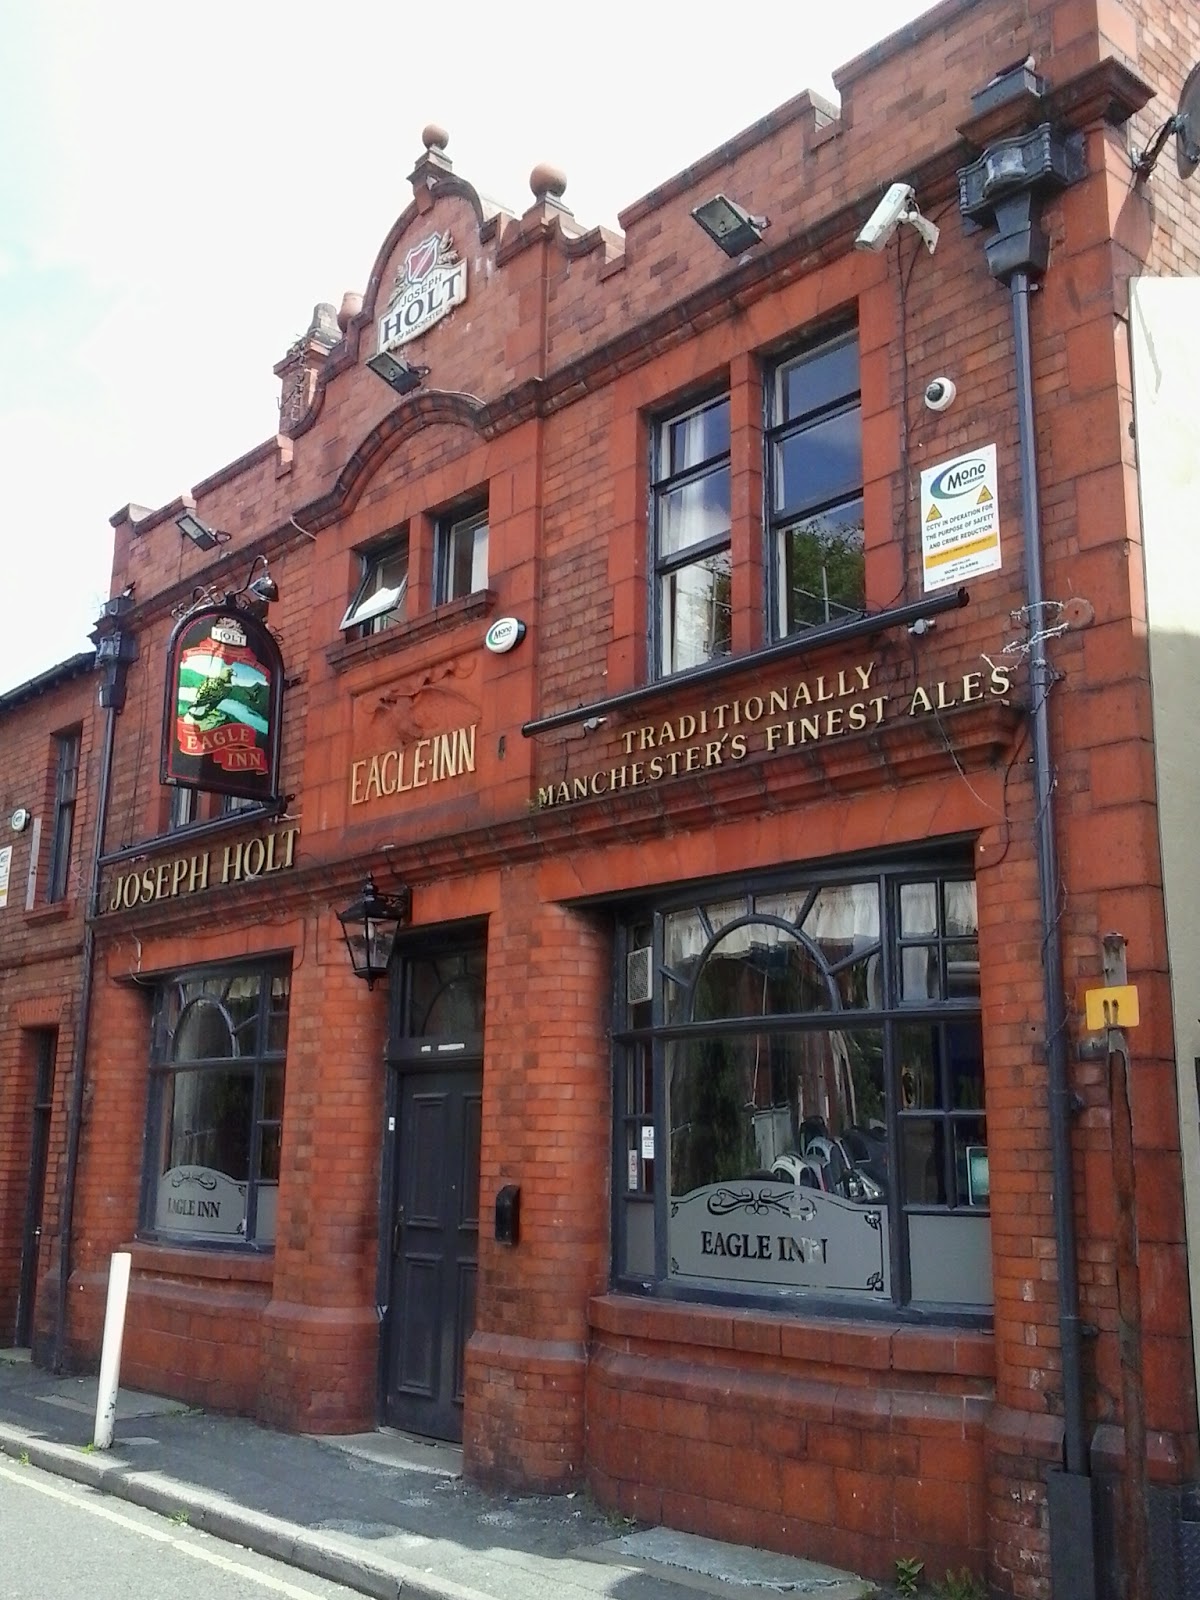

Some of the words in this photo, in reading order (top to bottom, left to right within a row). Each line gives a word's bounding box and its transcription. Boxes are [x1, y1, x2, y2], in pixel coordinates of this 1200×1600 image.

[401, 273, 442, 307] JOSEPH
[382, 271, 462, 344] HOLT
[947, 463, 986, 491] Mono
[926, 521, 941, 532] CCTV
[949, 508, 981, 523] OPERATION
[981, 503, 993, 512] FOR
[938, 524, 963, 537] PURPOSE
[973, 513, 994, 525] SAFETY
[929, 542, 941, 550] AND
[941, 535, 959, 546] CRIME
[960, 524, 993, 540] REDUCTION
[493, 625, 512, 640] Mono
[621, 661, 877, 754] TRADITIONALLY
[186, 728, 250, 750] EAGLE
[537, 732, 747, 808] MANCHESTER'S
[765, 695, 889, 751] FINEST
[909, 665, 1011, 716] ALES
[227, 747, 261, 767] INN
[110, 852, 210, 911] JOSEPH
[221, 827, 301, 884] HOLT
[197, 1201, 221, 1218] INN
[701, 1230, 773, 1260] EAGLE
[777, 1235, 828, 1265] INN
